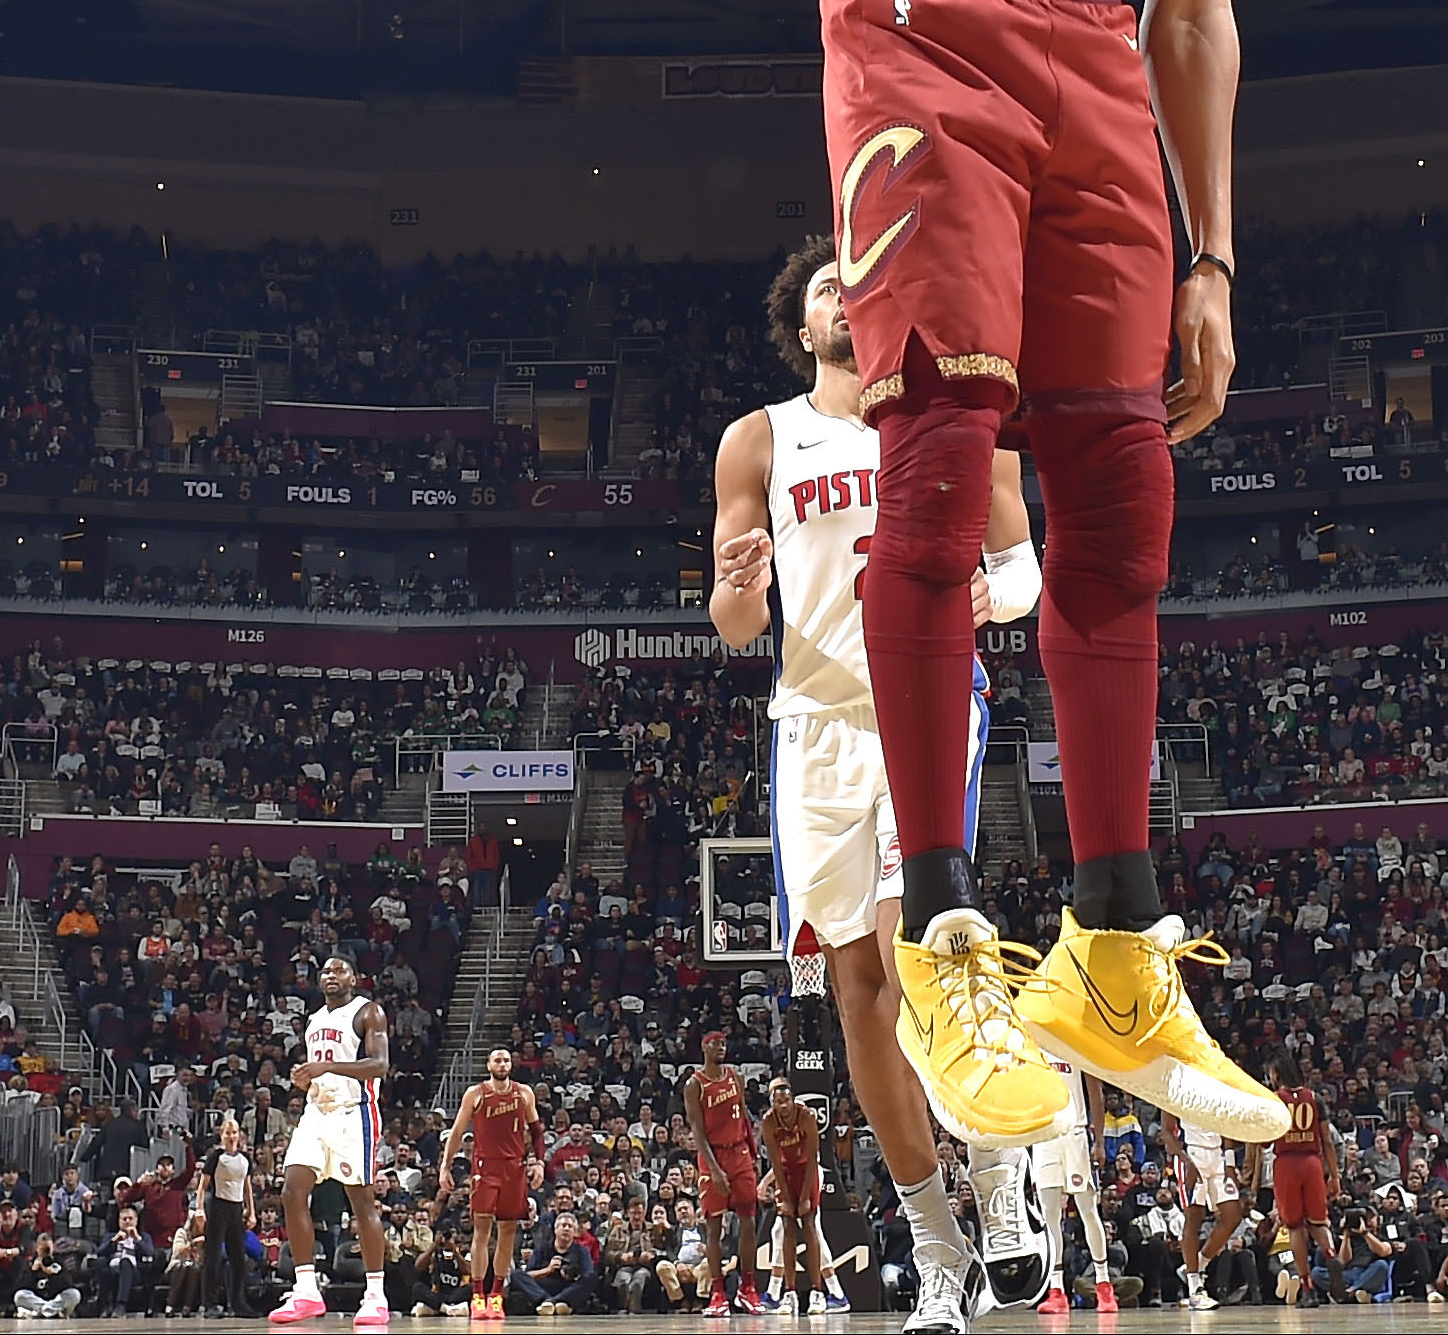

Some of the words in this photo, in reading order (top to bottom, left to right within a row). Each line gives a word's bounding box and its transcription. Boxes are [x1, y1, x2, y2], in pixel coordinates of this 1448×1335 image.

[1351, 340, 1372, 350] 202
[1424, 333, 1445, 344] 203
[516, 366, 536, 376] 231
[587, 366, 607, 376] 201
[1210, 473, 1276, 493] FOULS
[1293, 468, 1308, 488] 2
[1342, 465, 1383, 483] TOL
[183, 481, 223, 499] TOL
[286, 486, 351, 504] FOULS
[411, 489, 458, 506] FG%
[471, 487, 496, 506] 56
[604, 484, 633, 505] 55
[788, 469, 878, 525] PIST
[1330, 611, 1368, 627] M102
[228, 628, 265, 643] M126
[492, 763, 570, 779] CLIFFS
[797, 1051, 824, 1060] SEAT
[795, 1060, 825, 1071] GEEK
